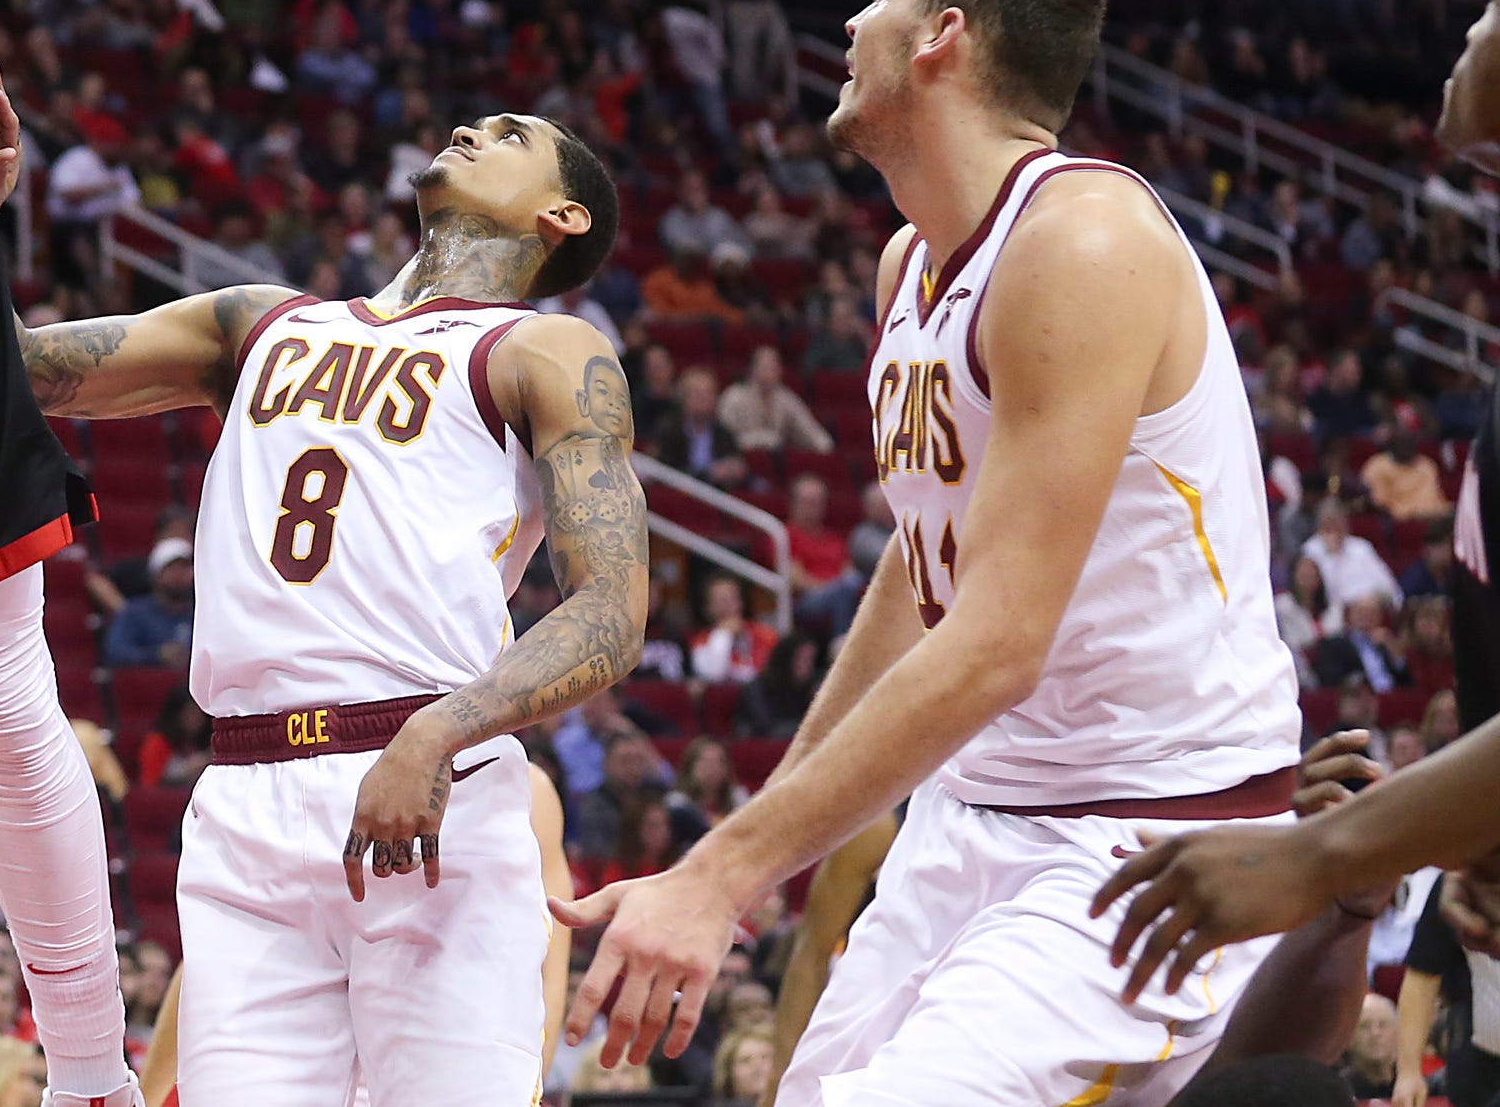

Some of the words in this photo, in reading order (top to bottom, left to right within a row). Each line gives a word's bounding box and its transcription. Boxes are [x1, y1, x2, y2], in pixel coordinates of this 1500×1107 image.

[247, 337, 448, 446] CAVS
[879, 359, 967, 485] CAVS
[269, 446, 350, 586] 8
[287, 709, 330, 746] CLE
